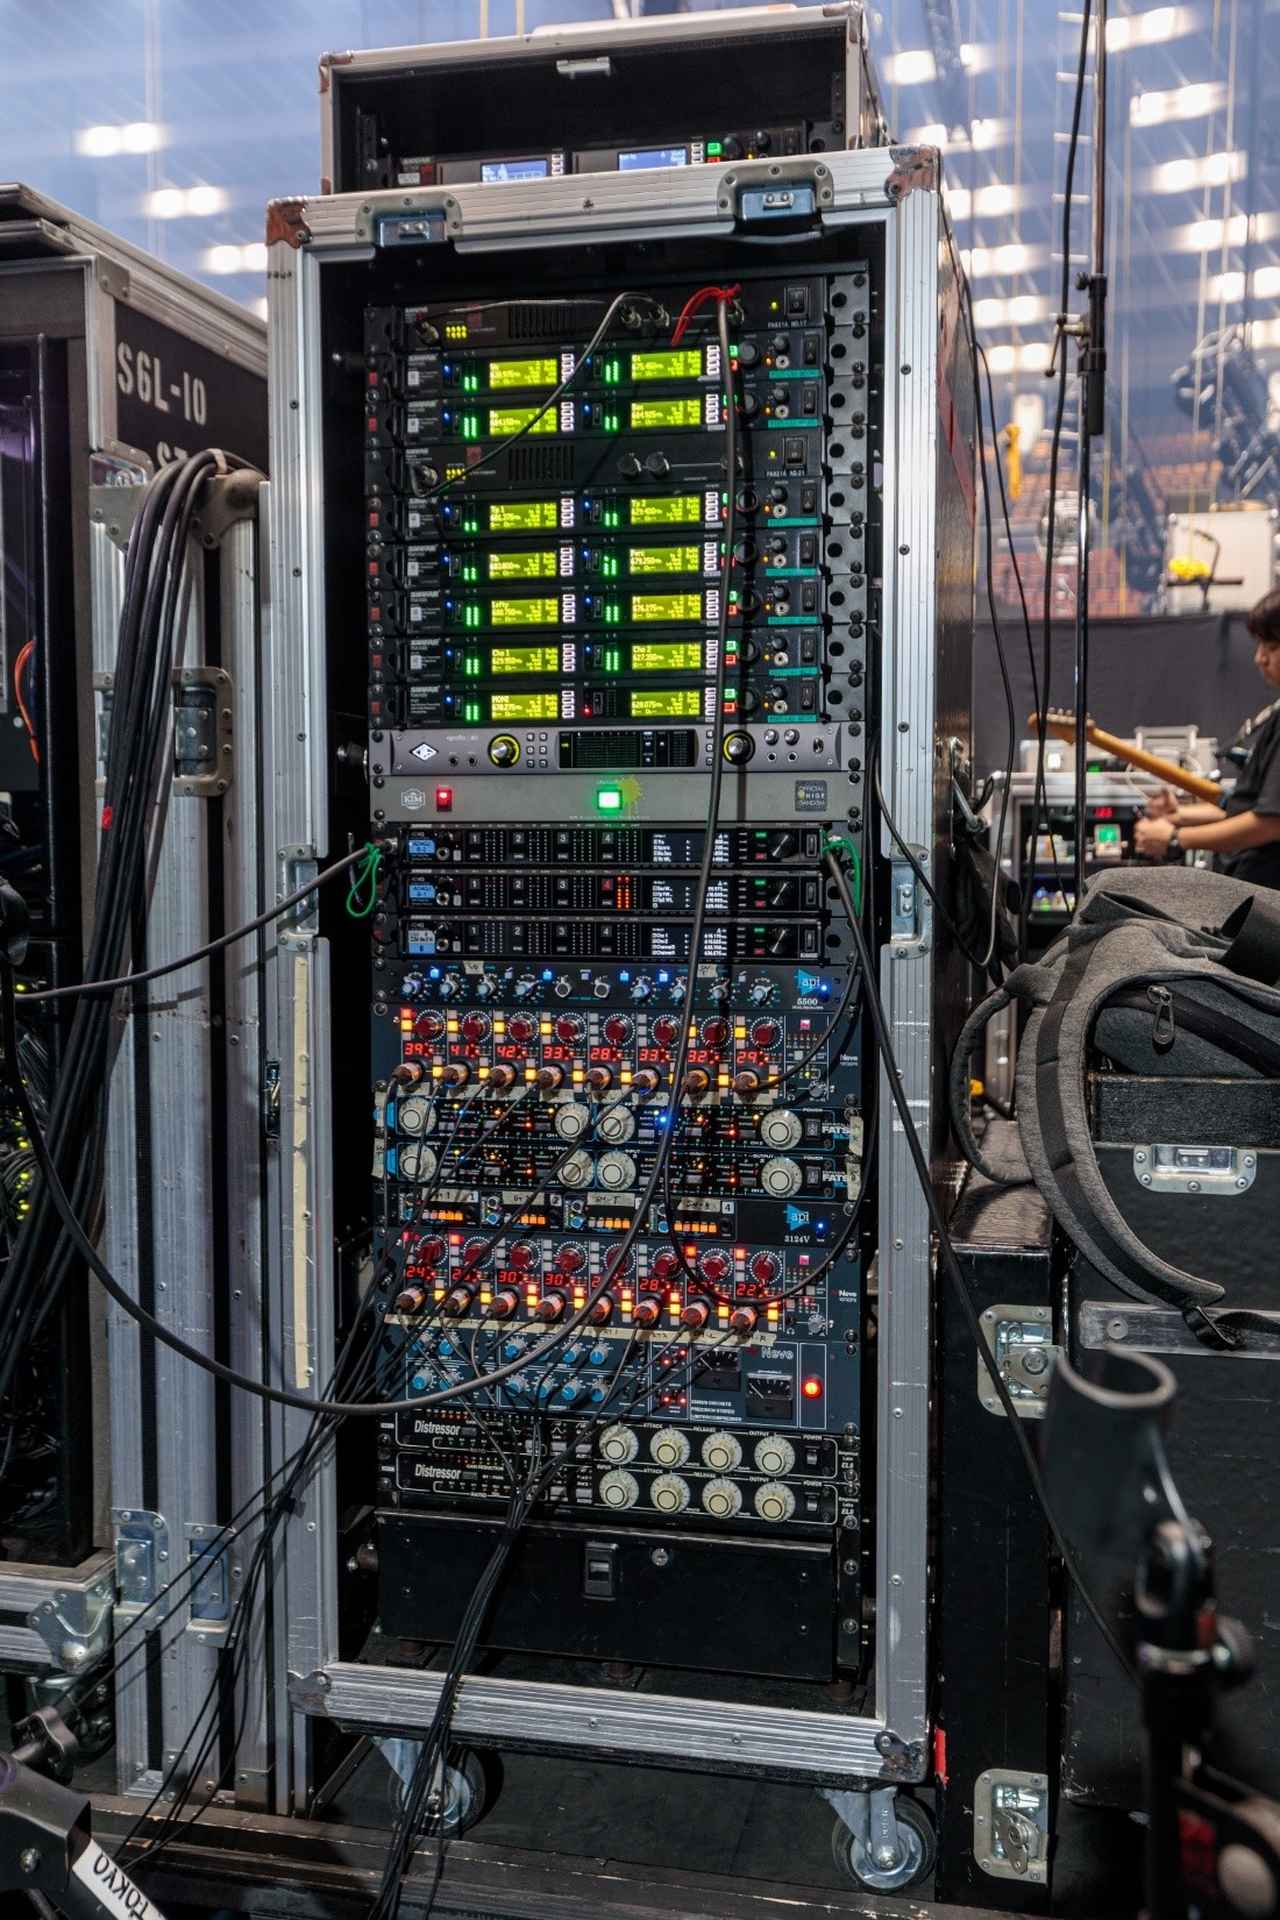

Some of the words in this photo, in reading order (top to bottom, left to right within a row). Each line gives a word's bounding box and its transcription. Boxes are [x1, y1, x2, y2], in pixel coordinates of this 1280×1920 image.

[117, 341, 207, 426] SGL-10
[515, 835, 521, 843] 2
[604, 835, 611, 843] 4
[515, 880, 521, 888] 2
[604, 880, 611, 888] 4
[514, 927, 521, 935] 2
[603, 927, 609, 935] 4
[801, 976, 820, 989] api
[404, 1043, 423, 1055] 39
[450, 1044, 470, 1056] 41
[496, 1045, 516, 1058] 42
[543, 1047, 563, 1059] 33
[590, 1048, 610, 1061] 28
[639, 1049, 658, 1062] 33
[688, 1050, 707, 1063] 32
[737, 1051, 757, 1064] 29
[822, 1126, 850, 1134] FATS
[724, 1203, 732, 1212] 4
[789, 1210, 810, 1224] api
[406, 1266, 425, 1277] 24
[499, 1271, 517, 1283] 30
[545, 1273, 563, 1285] 30
[639, 1278, 658, 1291] 28
[736, 1283, 756, 1296] 22
[761, 1347, 794, 1360] Neve
[414, 1420, 460, 1436] Distressor
[415, 1464, 461, 1480] Distressor
[93, 1856, 151, 1920] TOKYO
